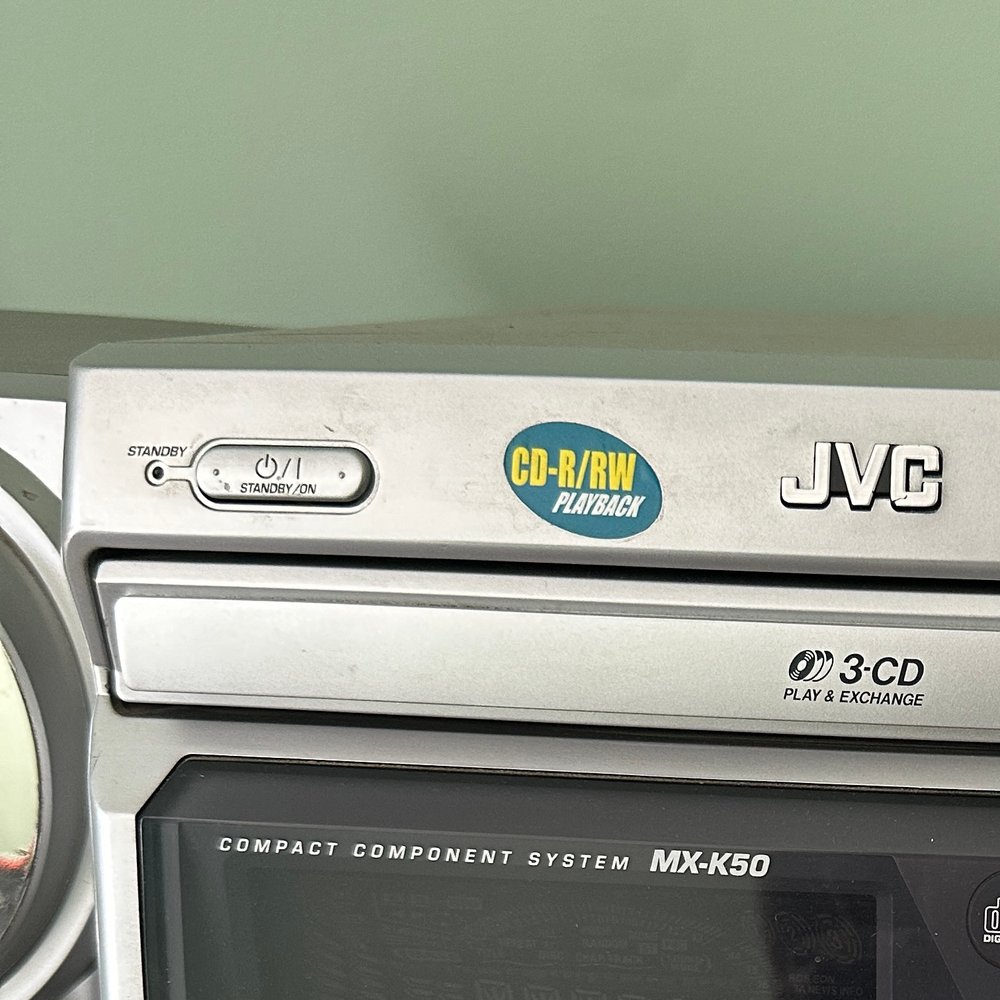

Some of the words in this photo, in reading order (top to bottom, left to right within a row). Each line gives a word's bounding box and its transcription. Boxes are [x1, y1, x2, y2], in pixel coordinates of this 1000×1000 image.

[127, 444, 188, 458] STANDBY
[511, 446, 636, 491] CD-R/RW
[780, 441, 943, 513] JVC
[240, 482, 317, 496] STANDBY/ON
[552, 491, 646, 518] PLAYBACK
[839, 653, 925, 686] 3-CD
[783, 688, 822, 701] PLAY
[824, 690, 835, 702] &
[839, 690, 925, 706] EXCHANGE
[219, 837, 340, 857] COMPACT
[353, 843, 513, 866] COMPONENT
[528, 852, 630, 871] SYSTEM
[650, 849, 771, 878] MX-K50
